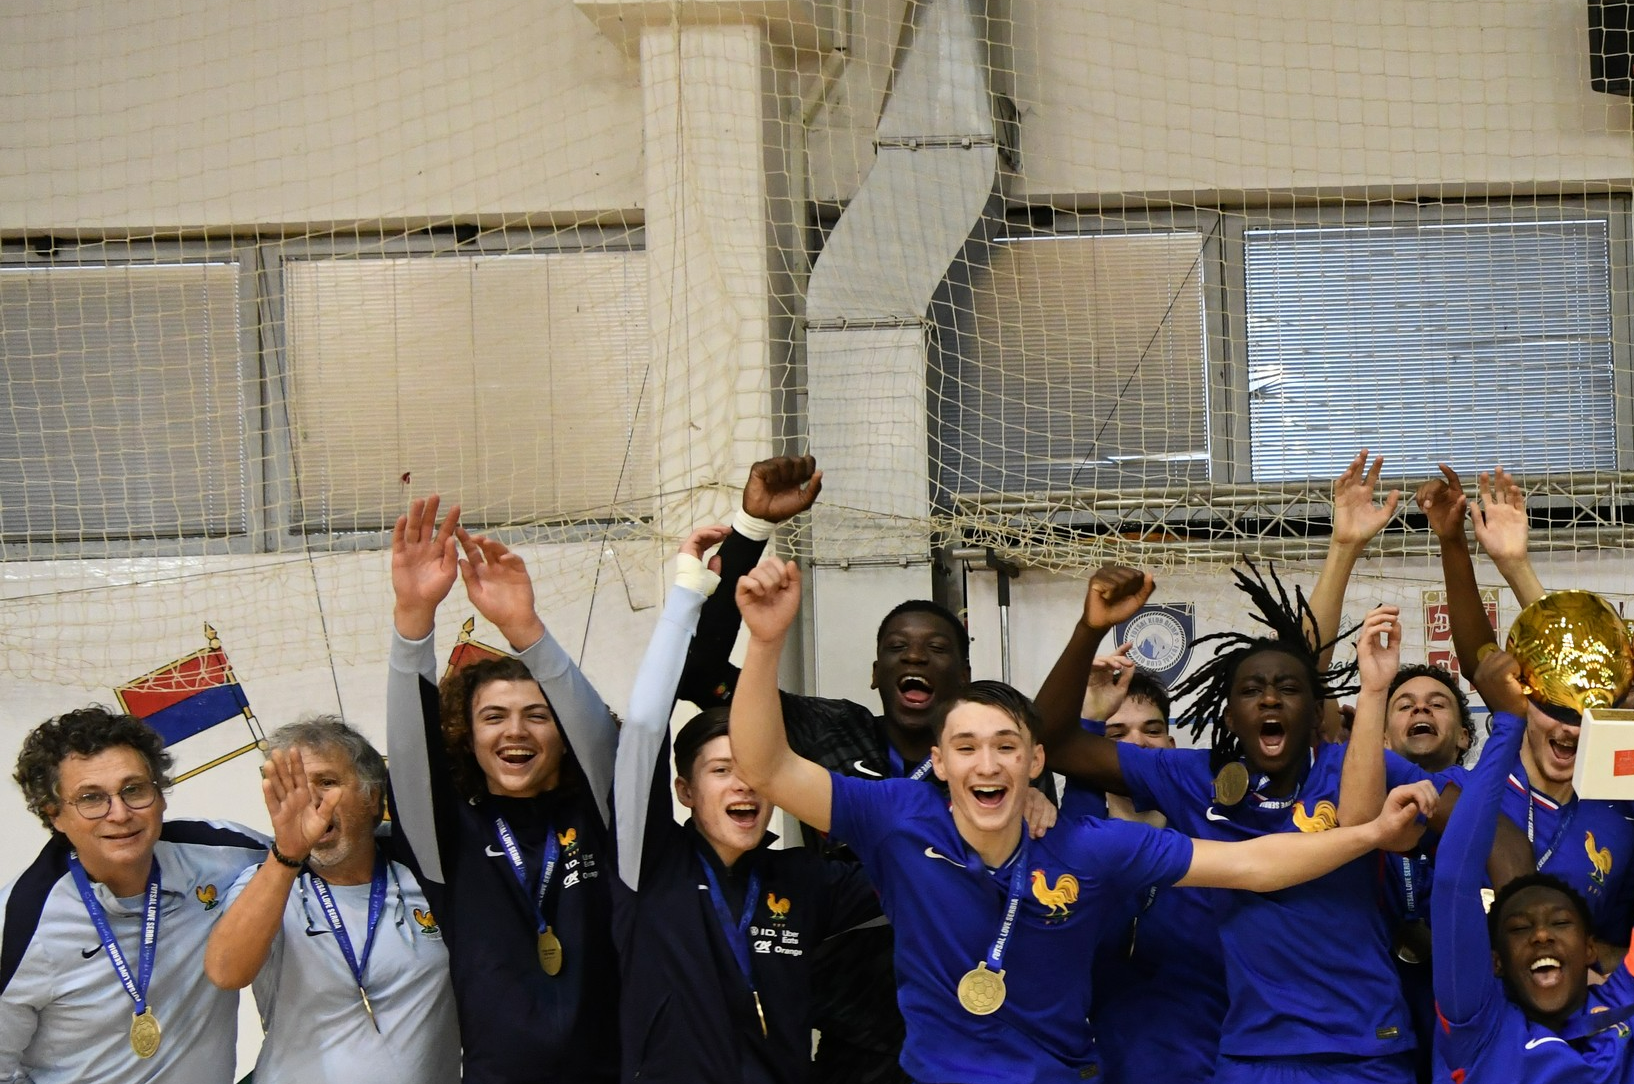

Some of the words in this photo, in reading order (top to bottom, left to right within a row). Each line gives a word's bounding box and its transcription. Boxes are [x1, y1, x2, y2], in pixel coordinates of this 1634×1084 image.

[502, 834, 514, 850] LOVE
[508, 845, 524, 868] SERBIA
[149, 883, 159, 906] FUTSAL
[1404, 878, 1413, 891] LOVE
[321, 894, 334, 910] LOVE
[1005, 898, 1019, 922] SERBIA
[147, 906, 157, 923] LOVE
[327, 907, 342, 932] SERBIA
[145, 921, 155, 945] SERBIA
[1000, 921, 1012, 938] LOVE
[108, 943, 123, 967] SERBIA
[774, 946, 803, 957] Orange
[991, 937, 1006, 961] FUTSAL
[117, 965, 131, 981] LOVE
[125, 978, 142, 1002] FUTSAL
